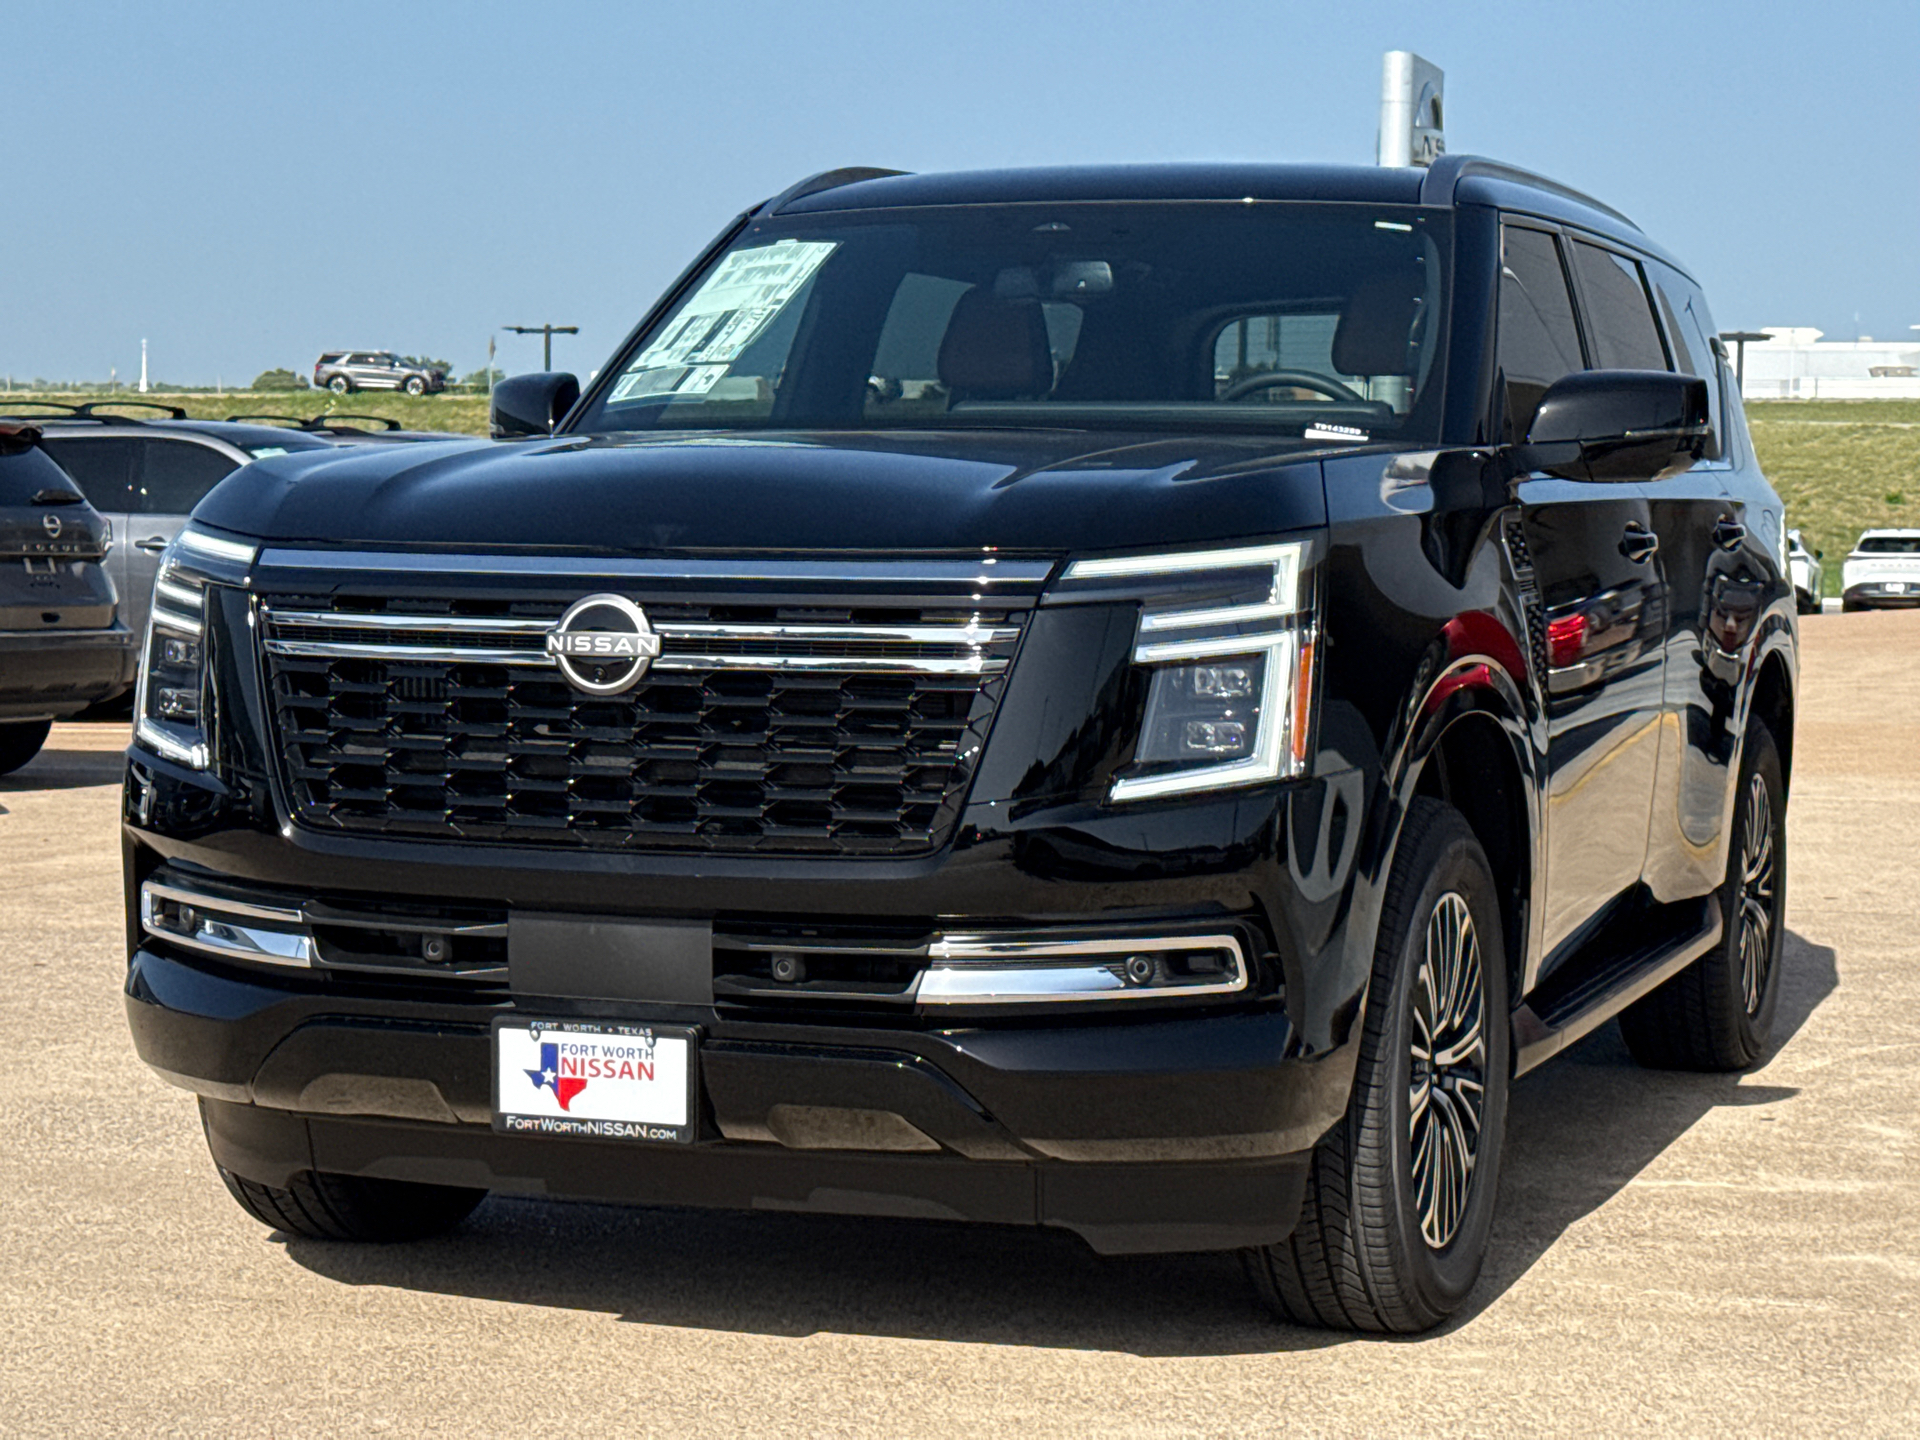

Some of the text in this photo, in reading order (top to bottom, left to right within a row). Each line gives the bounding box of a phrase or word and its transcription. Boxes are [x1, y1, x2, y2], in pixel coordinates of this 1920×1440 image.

[548, 635, 657, 654] NISSAN
[530, 1021, 653, 1036] FORT WORTH TEXAS
[561, 1043, 655, 1060] FORT WORTH
[561, 1056, 655, 1081] NISSAN
